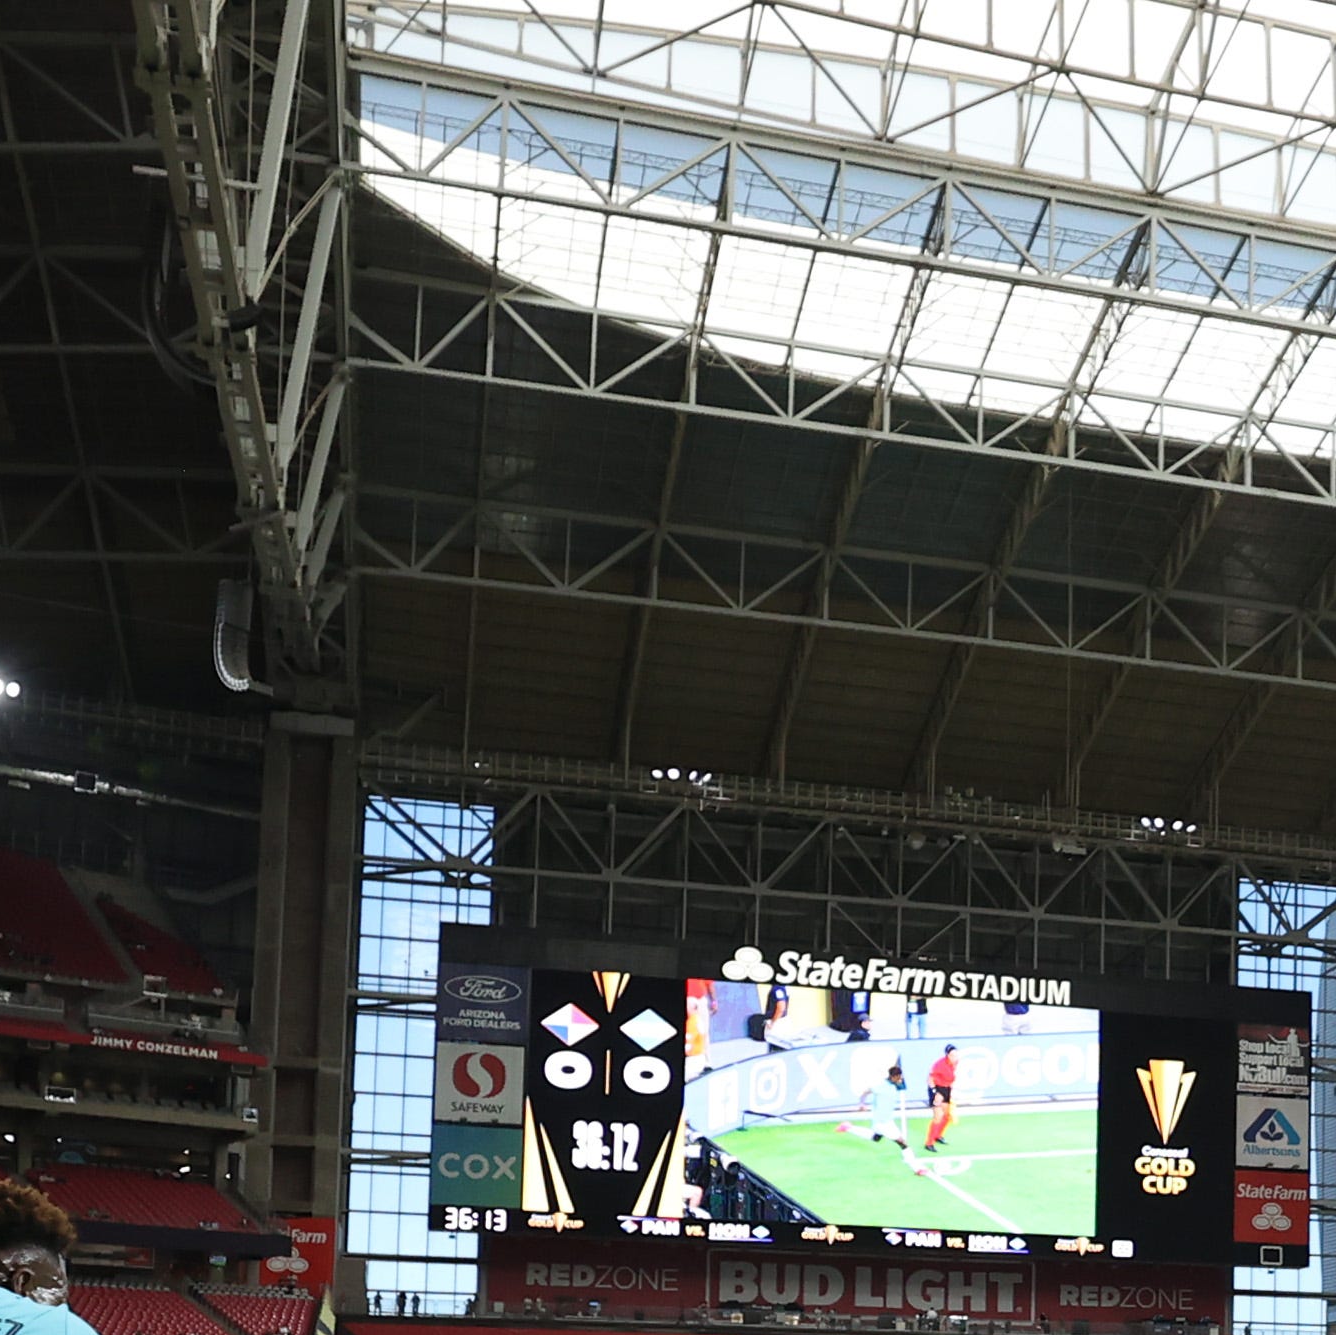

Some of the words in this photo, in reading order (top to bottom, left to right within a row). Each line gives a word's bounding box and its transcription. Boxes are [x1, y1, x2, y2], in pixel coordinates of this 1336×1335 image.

[459, 977, 507, 999] Ford
[949, 970, 1071, 1006] STADIUM
[443, 1017, 472, 1027] FORD
[473, 1020, 521, 1031] DEALERS
[459, 1008, 506, 1020] ARIZONA
[90, 1036, 133, 1050] JIMMY
[136, 1040, 218, 1060] CONZELMAN
[1238, 1039, 1264, 1054] Shop
[1238, 1052, 1278, 1066] Support
[544, 1050, 593, 1090] 0
[623, 1055, 672, 1094] 0
[451, 1101, 505, 1114] SAFEWAY
[1243, 1144, 1301, 1157] Albertsons
[438, 1152, 516, 1181] COX
[1134, 1156, 1196, 1177] GOLD
[1142, 1176, 1188, 1195] CUP
[641, 1219, 680, 1236] PAN
[905, 1232, 942, 1248] PAN
[526, 1263, 679, 1292] REDZONE
[719, 1261, 845, 1306] BUD
[855, 1266, 1023, 1313] LIGHT
[1059, 1284, 1194, 1311] REDZONE
